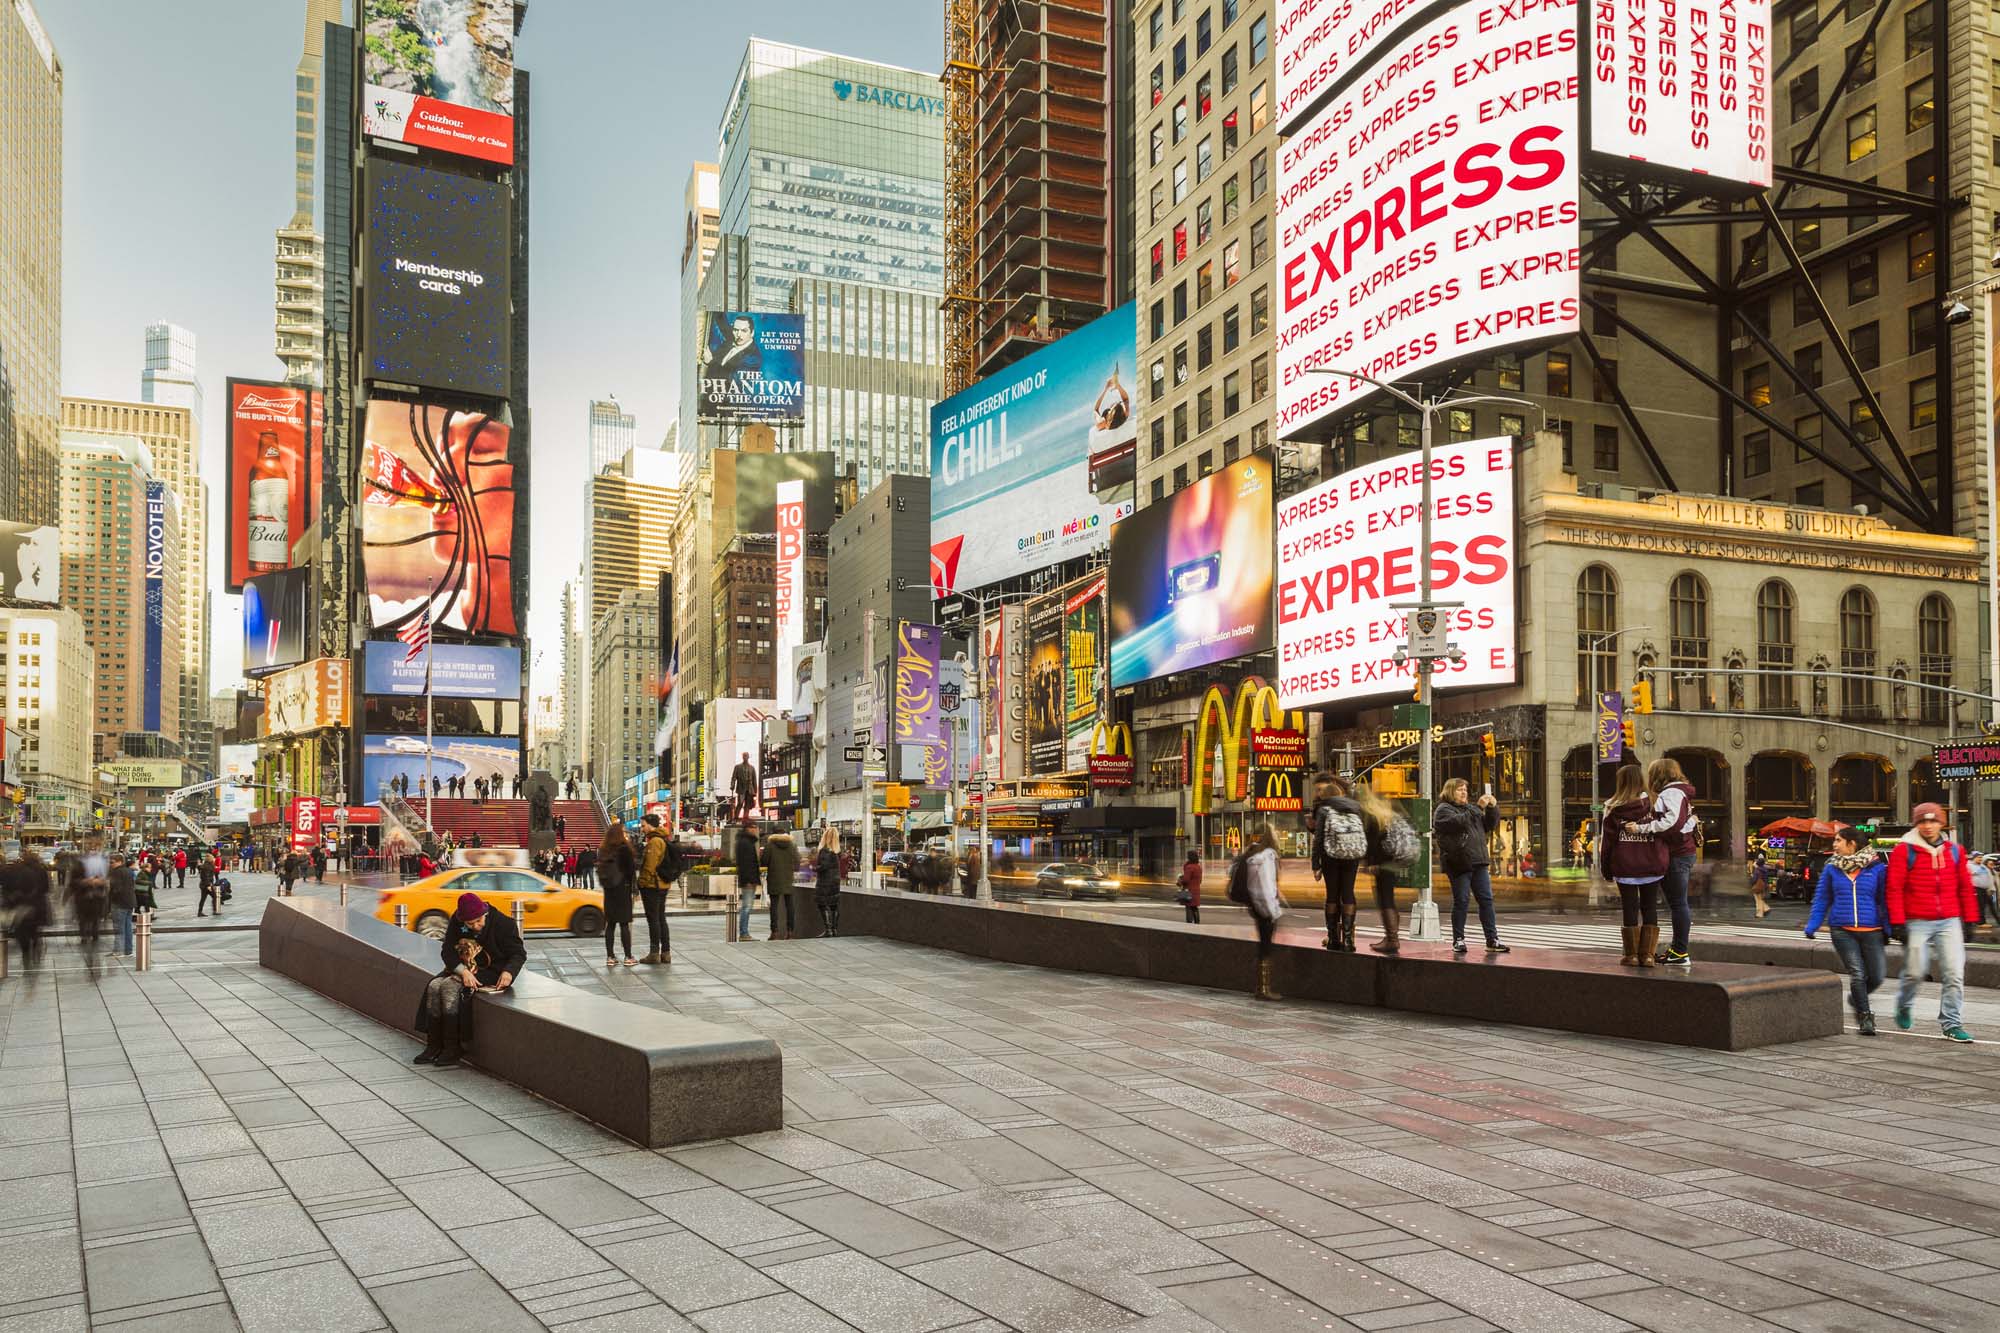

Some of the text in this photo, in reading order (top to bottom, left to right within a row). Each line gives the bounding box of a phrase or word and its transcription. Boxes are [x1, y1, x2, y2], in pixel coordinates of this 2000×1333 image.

[1283, 1, 1352, 76] EXPRESS
[1596, 0, 1615, 83] RESS
[1690, 8, 1708, 150] EXPRESS
[1748, 23, 1765, 162] EXPRESS
[856, 84, 944, 117] BARCLAYS
[1284, 101, 1353, 173] EXPRESS
[1363, 25, 1459, 107] EXPRESS
[414, 122, 426, 130] the
[427, 125, 451, 136] hidden
[452, 130, 476, 142] beauty
[477, 136, 485, 144] of
[486, 137, 507, 148] China
[419, 110, 464, 128] Guizhou:
[1349, 80, 1436, 158] EXPRESS
[1284, 76, 1578, 248] EXPRESS EXPRESS EXPRE
[1284, 125, 1565, 313] EXPRESS
[395, 258, 483, 287] Membership
[419, 278, 461, 295] cards
[1349, 241, 1437, 308] EXPRESS
[1284, 248, 1579, 386] EXPRESS EXPRESS EXPRE
[737, 370, 763, 380] THE
[1349, 333, 1437, 392] EXPRESS
[700, 379, 802, 396] PHANTOM
[708, 393, 793, 405] OF THE OPERA
[941, 369, 1048, 436] FEEL A DIFFERENT KIND OF
[235, 411, 251, 419] THIS
[274, 415, 286, 423] FOR
[942, 411, 1022, 486] CHILL.
[1279, 488, 1338, 531] XPRESS
[1350, 455, 1465, 501] EXPRESS
[779, 505, 801, 528] 10
[1696, 504, 1767, 527] MILLER
[1784, 510, 1866, 537] BUILDING
[146, 492, 163, 579] NOVOTEL
[1283, 520, 1354, 563] EXPRESS
[1564, 527, 1589, 544] THE
[1594, 530, 1631, 547] SHOW
[1638, 535, 1678, 552] FOLKS
[1682, 538, 1714, 555] SHOE
[1720, 543, 1751, 559] SHOP
[1755, 547, 1819, 566] DEDICATED
[1893, 561, 1905, 573] IN
[1912, 562, 1974, 579] FOOTWEAR
[1279, 535, 1508, 624] EXPRESS
[1070, 631, 1095, 667] BRONX
[1232, 624, 1255, 638] Industry
[1283, 627, 1355, 663] EXPRESS
[1010, 617, 1024, 743] PALACE
[1074, 667, 1093, 706] TALE
[1280, 668, 1340, 698] XPRESS
[941, 695, 957, 709] NFL
[1255, 736, 1305, 745] McDonald's
[1379, 724, 1444, 749] EXPRES
[1940, 766, 1976, 777] CAMERA
[1022, 788, 1085, 796] ILLUSIONISTS
[299, 800, 316, 831] tkts
